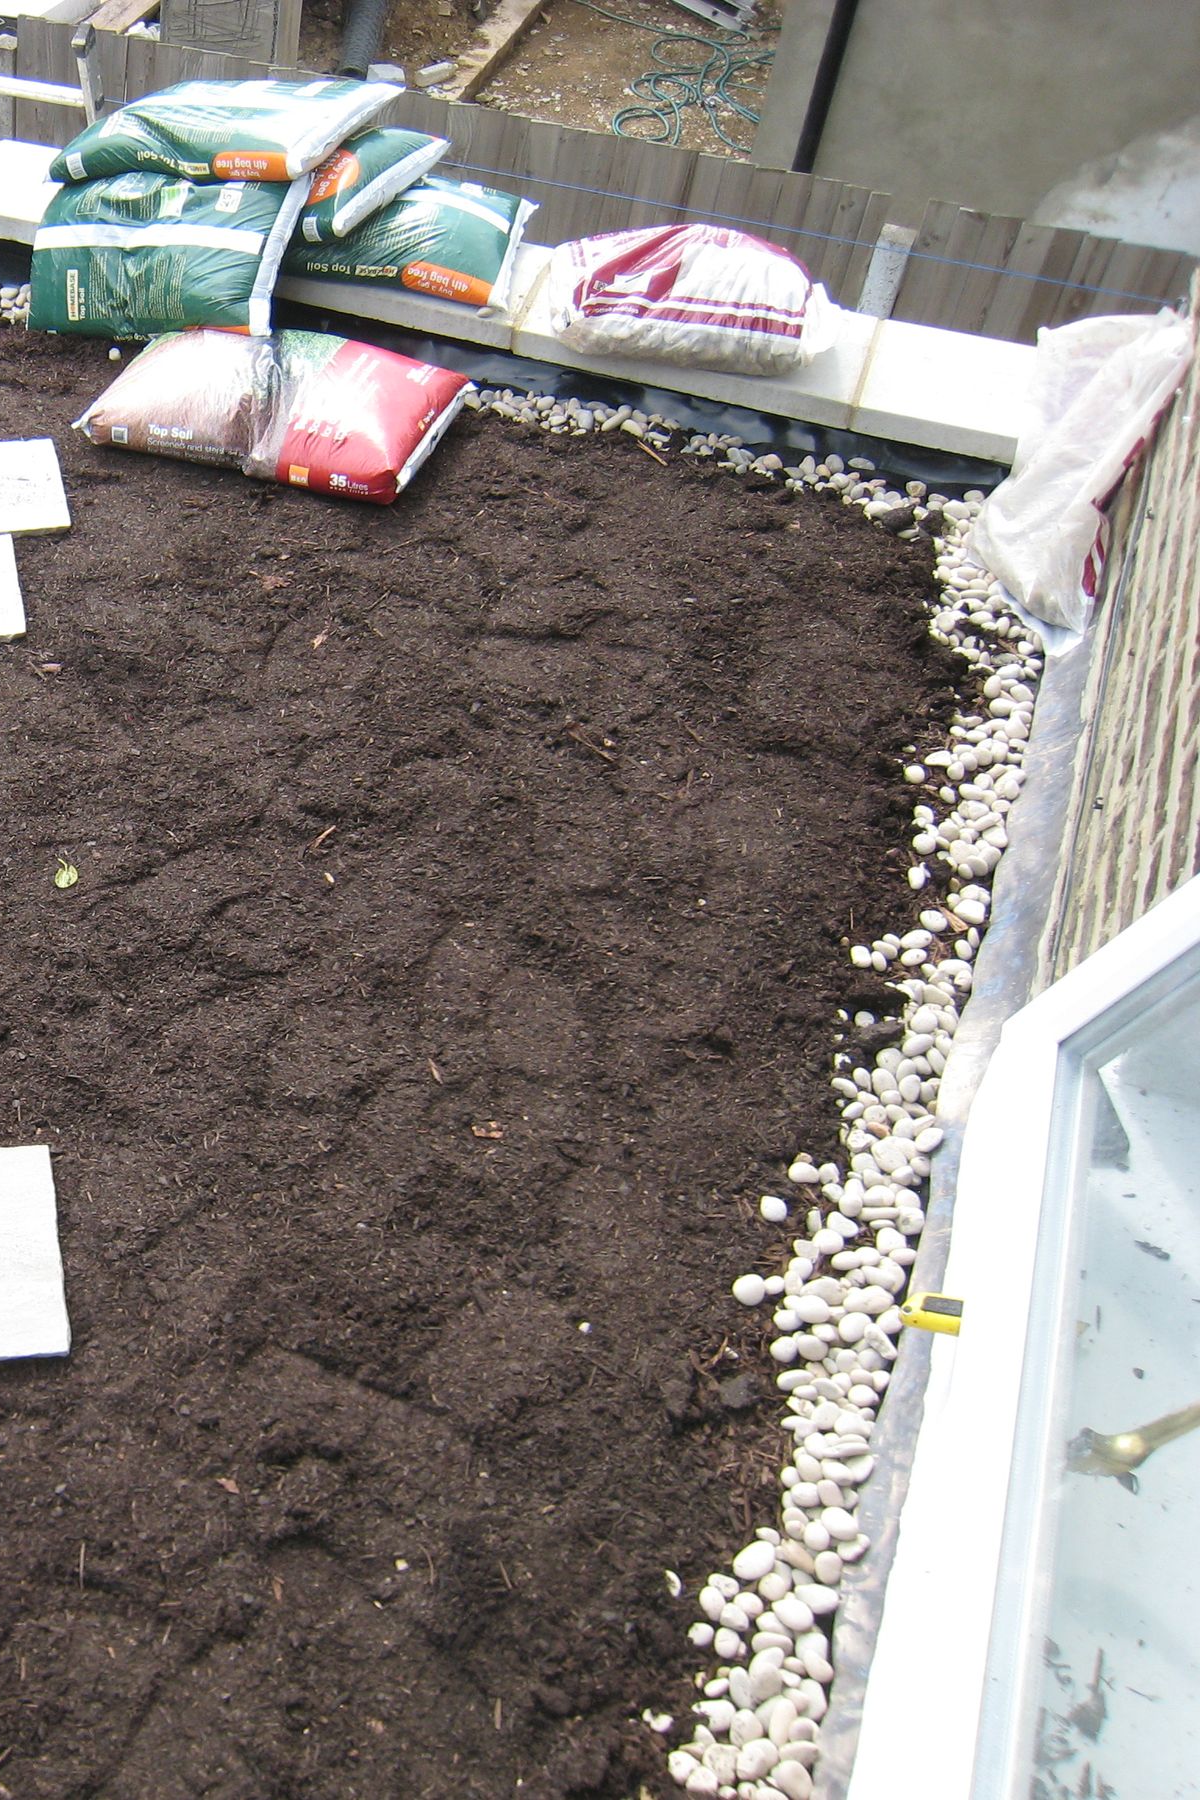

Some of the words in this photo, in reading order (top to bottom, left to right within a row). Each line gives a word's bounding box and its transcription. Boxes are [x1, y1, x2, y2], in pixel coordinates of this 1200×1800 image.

[136, 150, 158, 161] Soil
[215, 159, 233, 170] free
[234, 157, 252, 169] bag
[252, 160, 269, 171] 4th
[306, 261, 329, 273] Soil
[331, 262, 351, 275] Top
[407, 267, 428, 281] free
[429, 271, 450, 288] bag
[438, 285, 454, 297] buy
[451, 279, 469, 293] 4th
[68, 271, 77, 319] HOMEBASE
[79, 304, 87, 320] Top
[147, 423, 168, 438] Top
[170, 427, 193, 441] Soil
[329, 473, 348, 488] 35
[347, 480, 369, 491] Litres
